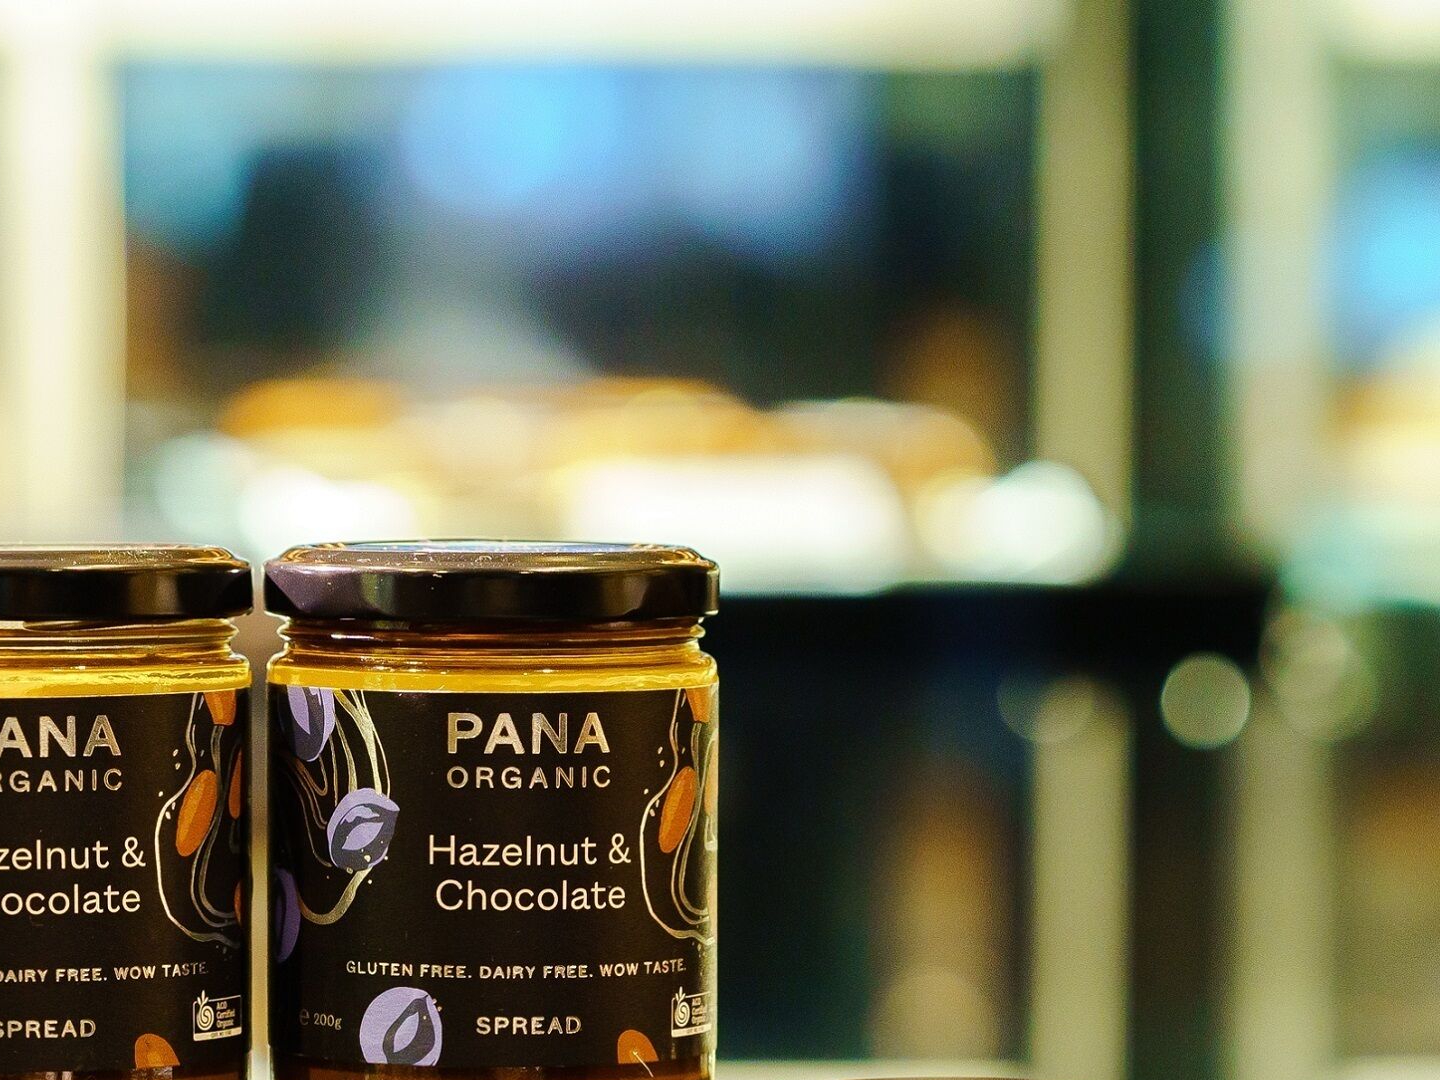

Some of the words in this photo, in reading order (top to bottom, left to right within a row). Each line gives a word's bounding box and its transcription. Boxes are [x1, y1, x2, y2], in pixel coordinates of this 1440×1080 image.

[447, 712, 610, 754] PANA
[447, 765, 611, 790] ORGANIC
[121, 837, 146, 867] &
[429, 834, 597, 866] Hazelnut
[609, 832, 631, 864] &
[436, 879, 625, 911] Chocolate
[56, 968, 107, 982] FREE.
[114, 965, 156, 981] WOW
[346, 960, 413, 978] GLUTEN
[420, 963, 472, 979] FREE.
[480, 965, 536, 980] DAIRY
[543, 964, 593, 979] FREE.
[599, 962, 639, 977] WOW
[643, 958, 687, 974] TASTE.
[313, 1012, 342, 1030] 200g
[476, 1016, 582, 1035] SPREAD
